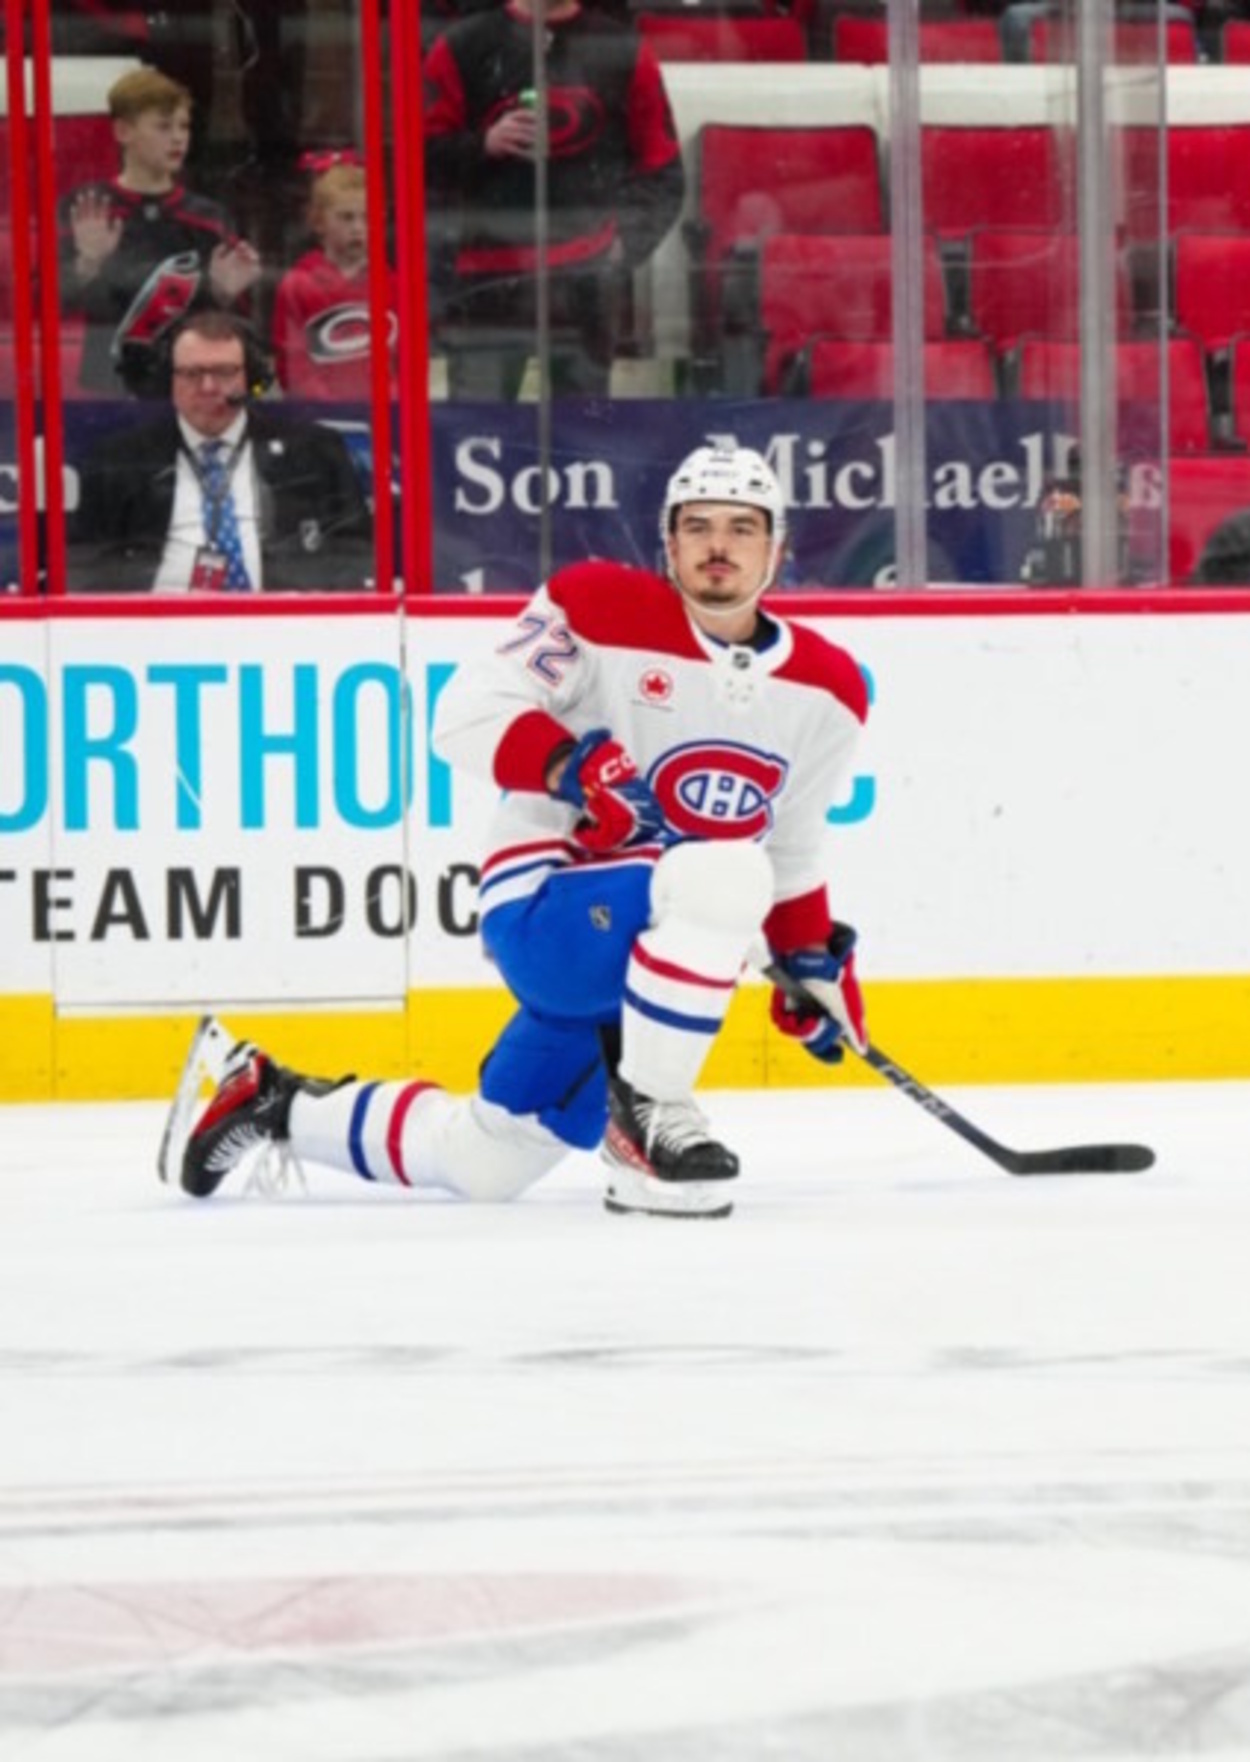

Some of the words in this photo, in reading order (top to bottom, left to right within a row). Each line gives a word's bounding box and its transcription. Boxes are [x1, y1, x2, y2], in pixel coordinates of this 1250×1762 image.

[455, 436, 619, 513] Son
[497, 612, 580, 688] 72
[0, 866, 242, 942] EAM
[294, 864, 481, 939] DOC
